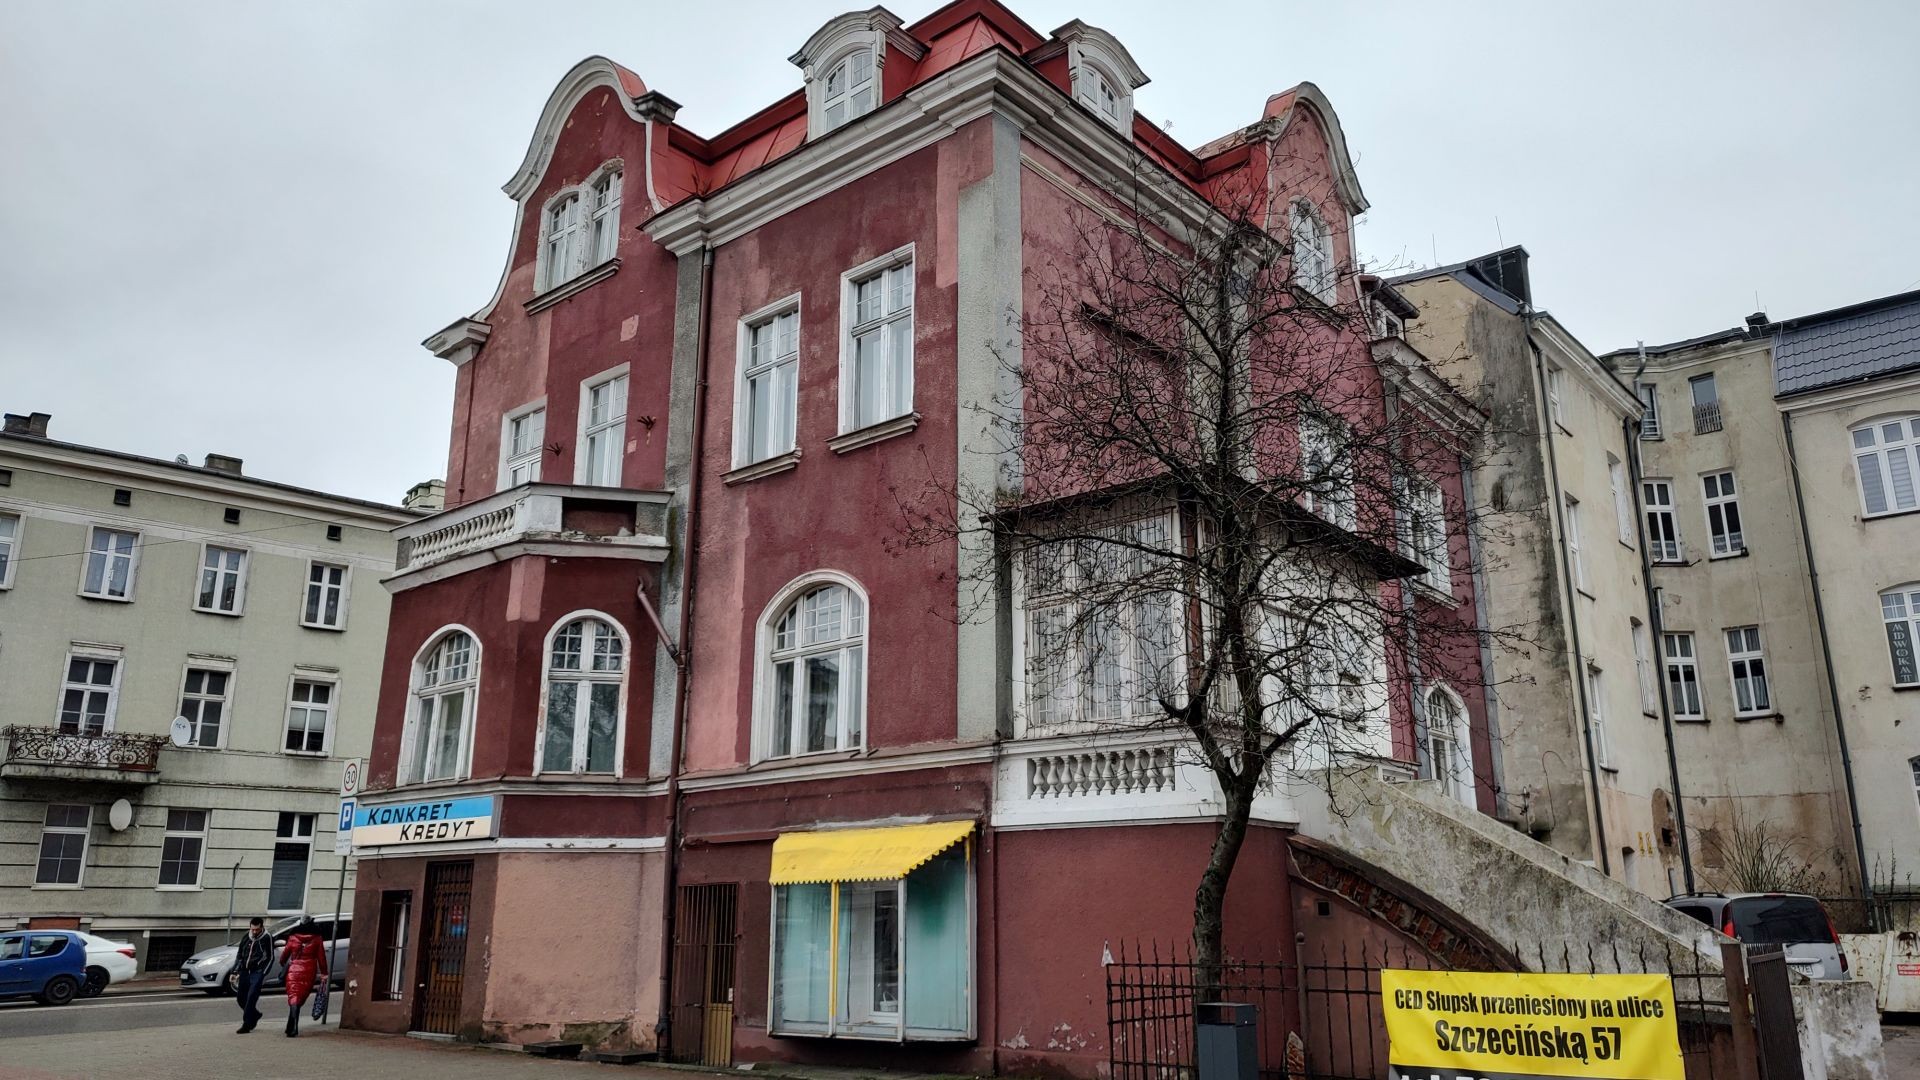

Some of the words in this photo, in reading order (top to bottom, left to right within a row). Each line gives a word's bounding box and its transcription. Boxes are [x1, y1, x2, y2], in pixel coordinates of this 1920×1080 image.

[345, 770, 356, 784] 30
[342, 806, 352, 828] P
[367, 803, 453, 825] KONKRET
[399, 820, 475, 841] KREDYT
[1395, 989, 1423, 1010] CED
[1426, 990, 1478, 1014] Słupsk
[1481, 993, 1587, 1019] przeniesiony
[1591, 1001, 1613, 1018] na
[1617, 996, 1664, 1019] ulice
[1435, 1019, 1589, 1065] Szczecińską
[1591, 1026, 1622, 1061] 57
